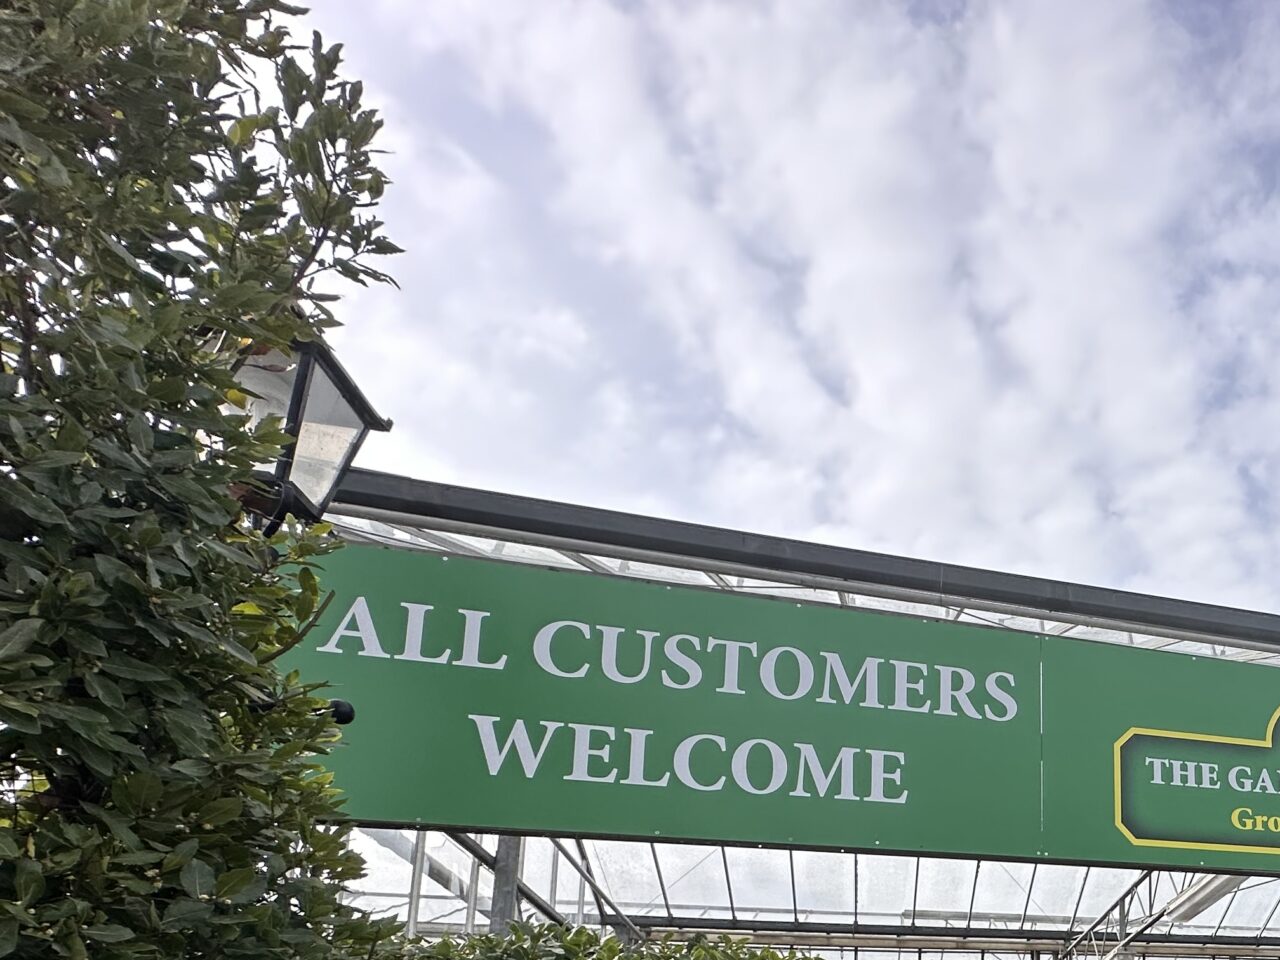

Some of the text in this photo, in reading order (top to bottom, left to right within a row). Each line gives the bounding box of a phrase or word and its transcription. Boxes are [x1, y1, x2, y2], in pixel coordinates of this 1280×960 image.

[315, 596, 1019, 722] ALL CUSTOMERS
[467, 713, 909, 804] WELCOME
[1145, 756, 1221, 790] THE
